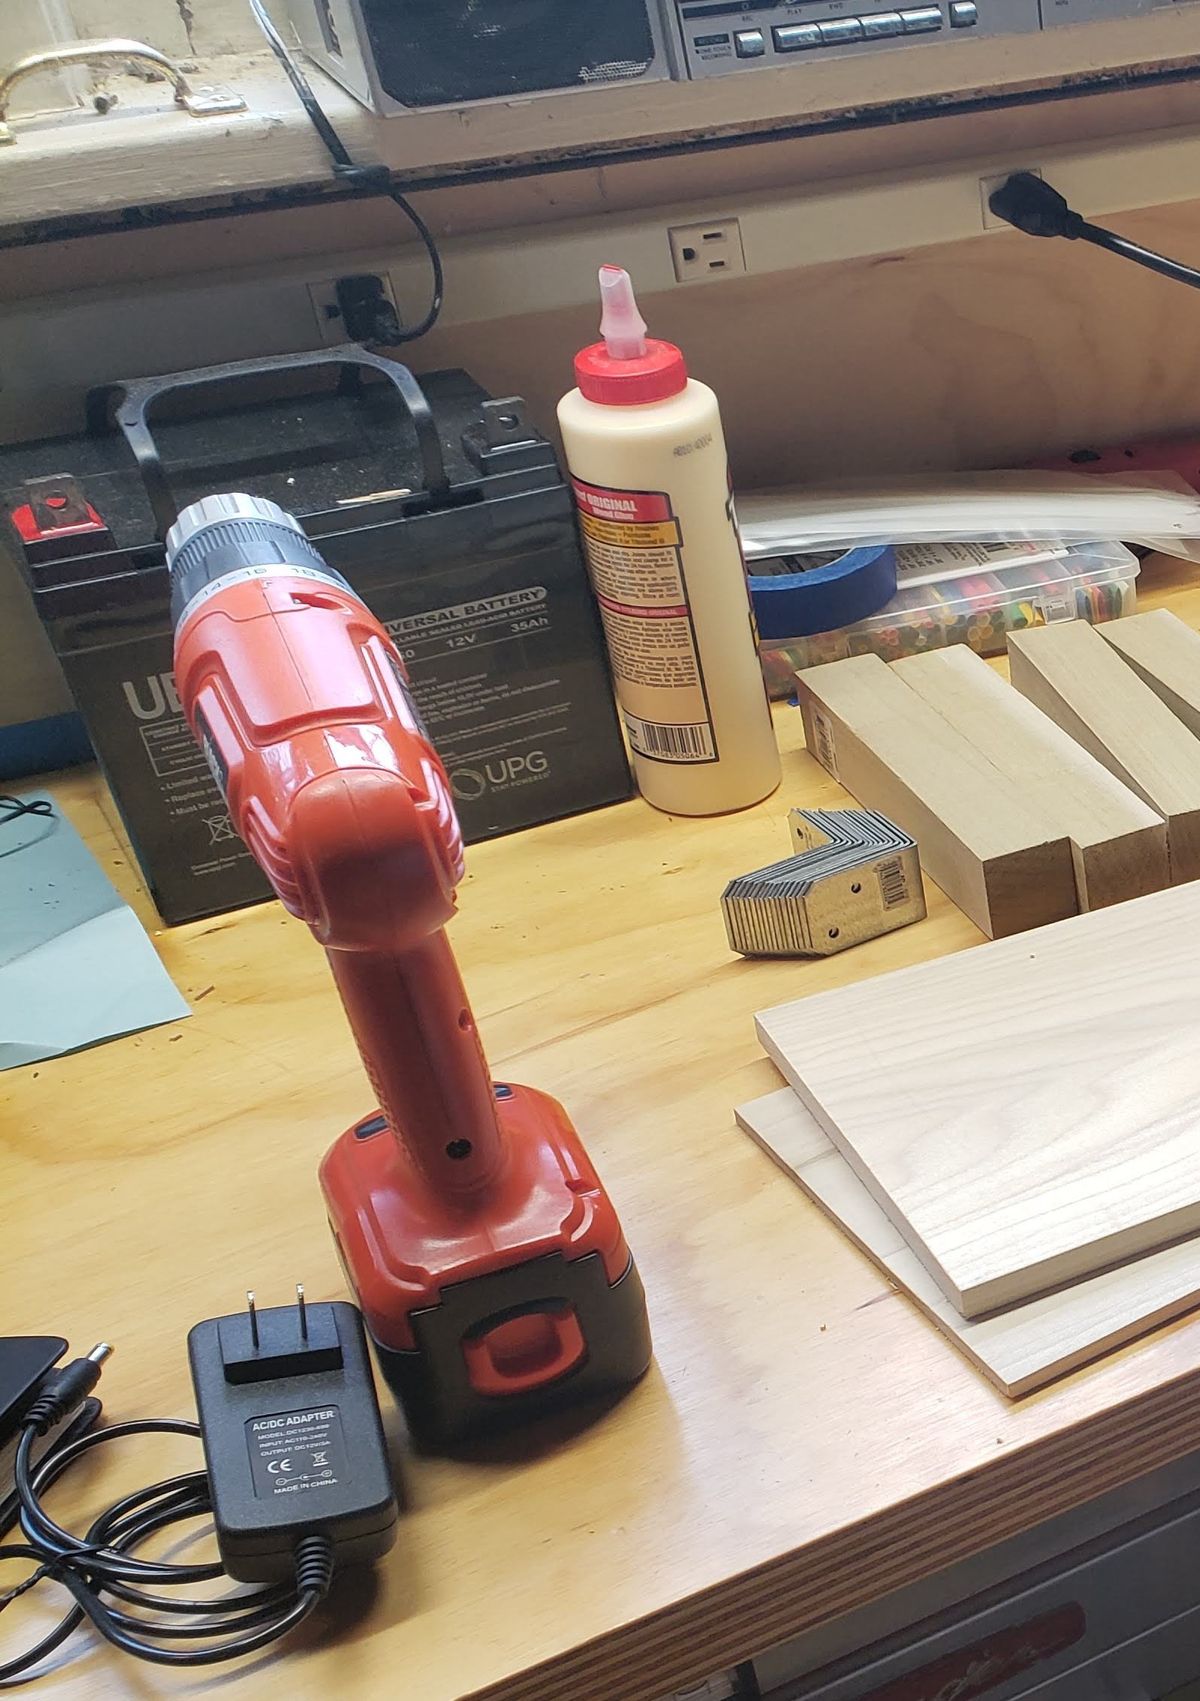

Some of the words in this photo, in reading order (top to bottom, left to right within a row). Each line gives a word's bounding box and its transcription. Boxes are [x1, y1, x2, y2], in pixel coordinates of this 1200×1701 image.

[587, 493, 638, 512] ORIGINAL
[386, 609, 461, 634] IVERSAL
[464, 590, 541, 615] BATTERY
[508, 603, 547, 617] BATTERY
[446, 632, 478, 648] 12V
[510, 617, 549, 633] 35Ah
[485, 750, 548, 783] UPG
[252, 1419, 285, 1431] AC/DC
[286, 1410, 335, 1425] ADAPTER
[273, 1485, 299, 1495] MADE
[310, 1478, 338, 1488] CHINA
